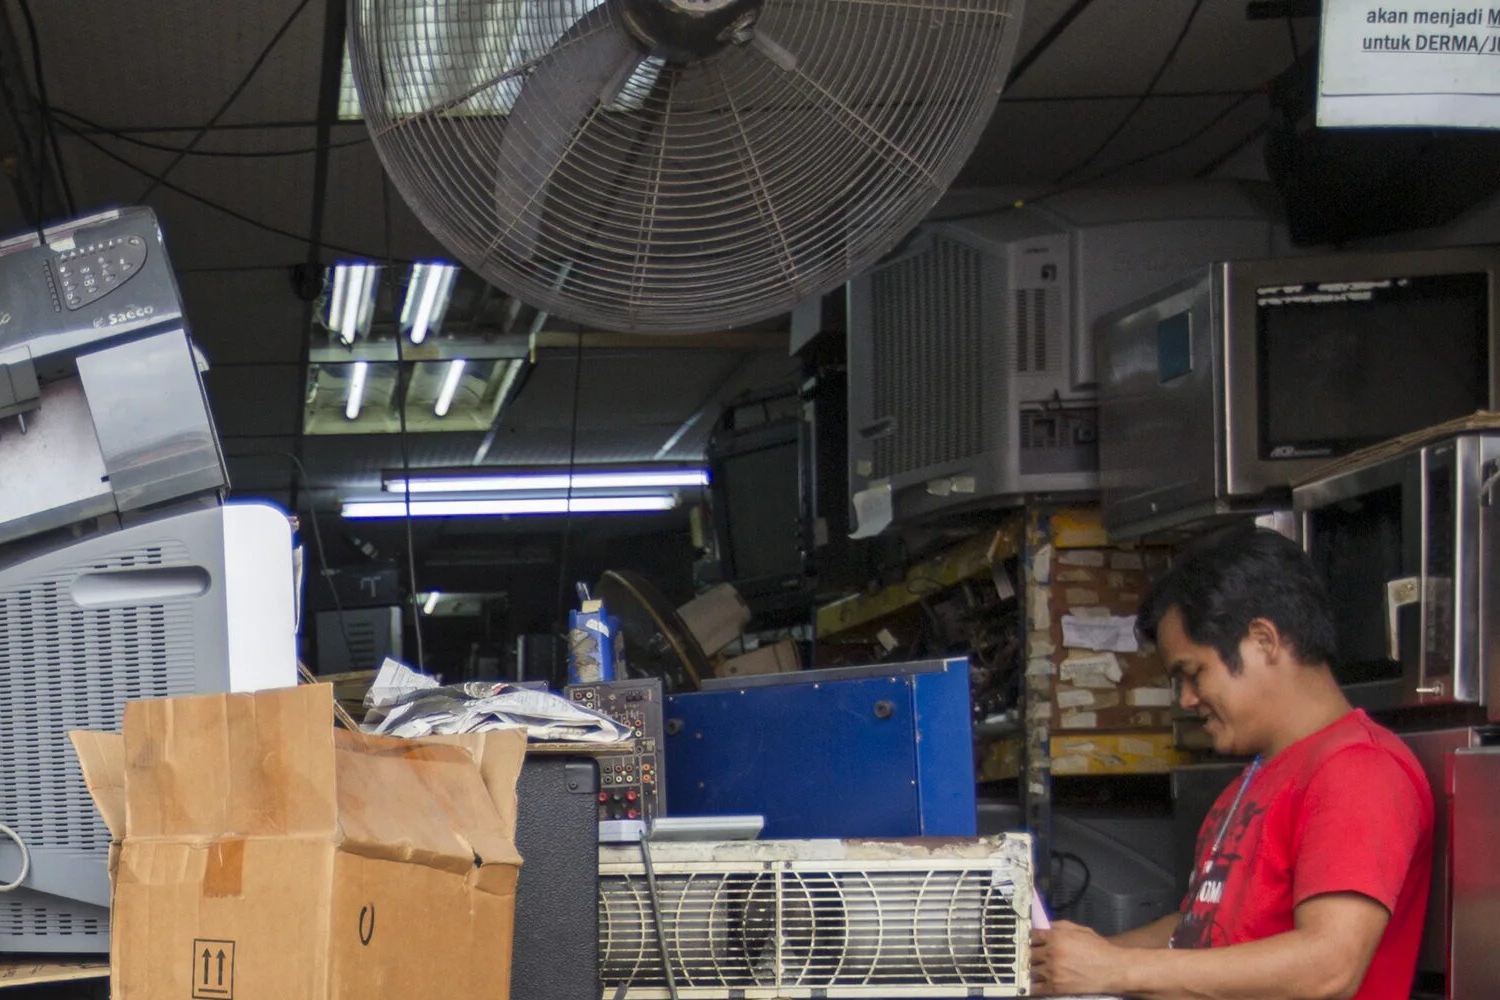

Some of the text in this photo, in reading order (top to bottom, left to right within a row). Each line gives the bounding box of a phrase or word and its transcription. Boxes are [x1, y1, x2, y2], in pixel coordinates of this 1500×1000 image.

[1366, 7, 1408, 24] akan
[1413, 7, 1483, 28] menjadi
[1362, 35, 1411, 50] untuk
[108, 304, 155, 327] Saeco
